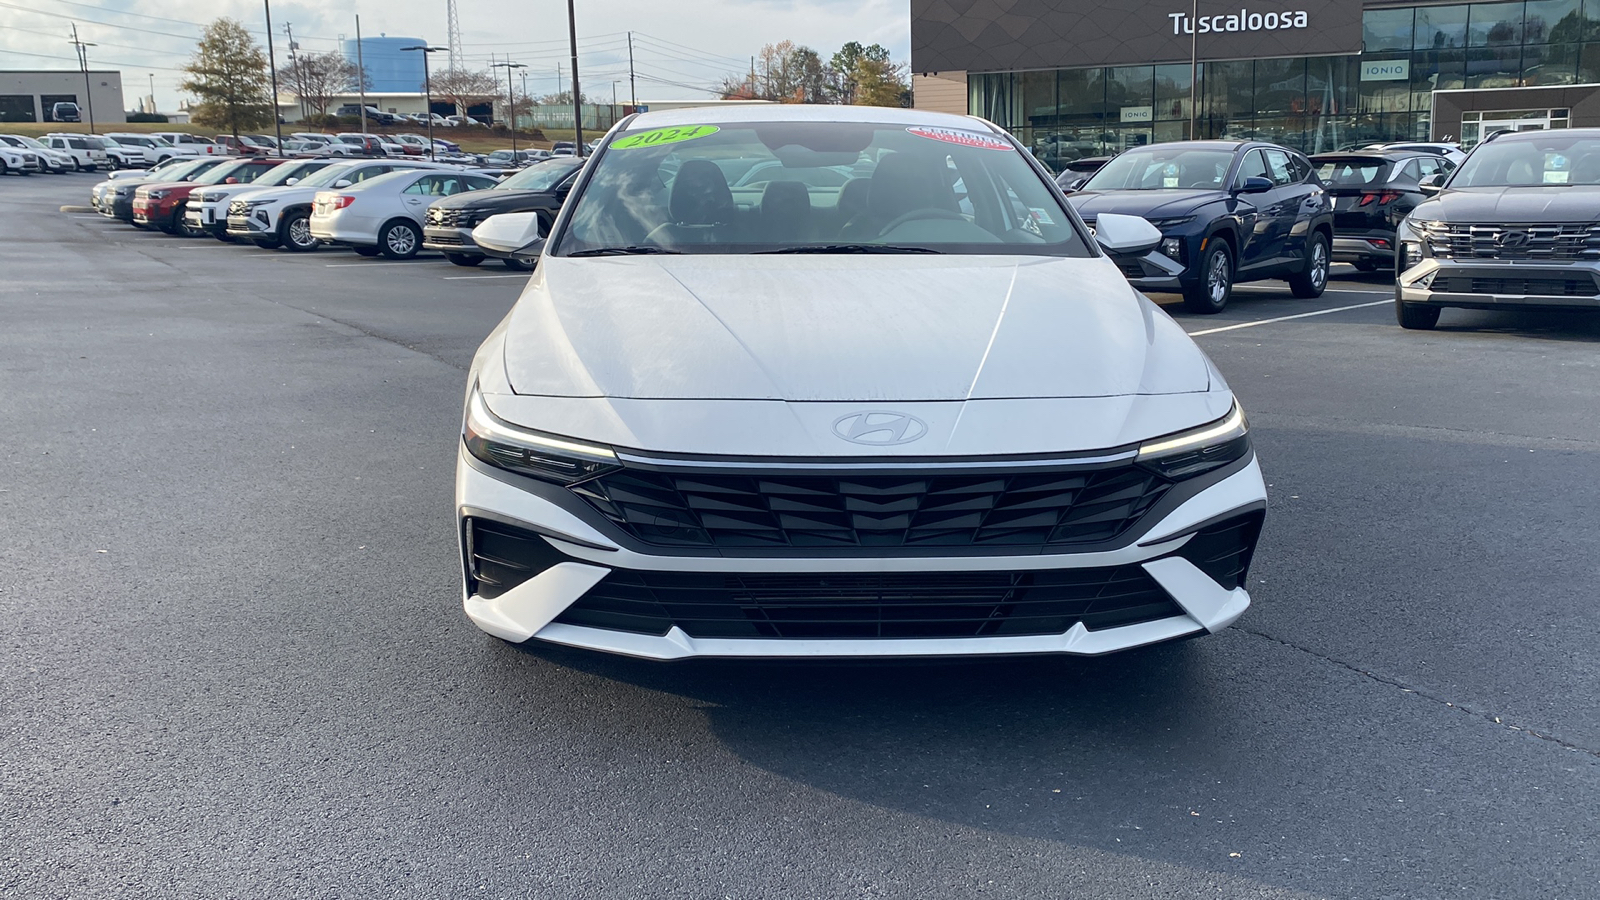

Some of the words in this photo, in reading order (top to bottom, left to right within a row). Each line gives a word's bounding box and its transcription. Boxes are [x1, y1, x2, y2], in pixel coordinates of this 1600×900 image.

[1168, 8, 1308, 35] Tuscaloosa
[1366, 66, 1403, 75] IONIQ
[624, 126, 702, 148] 2024
